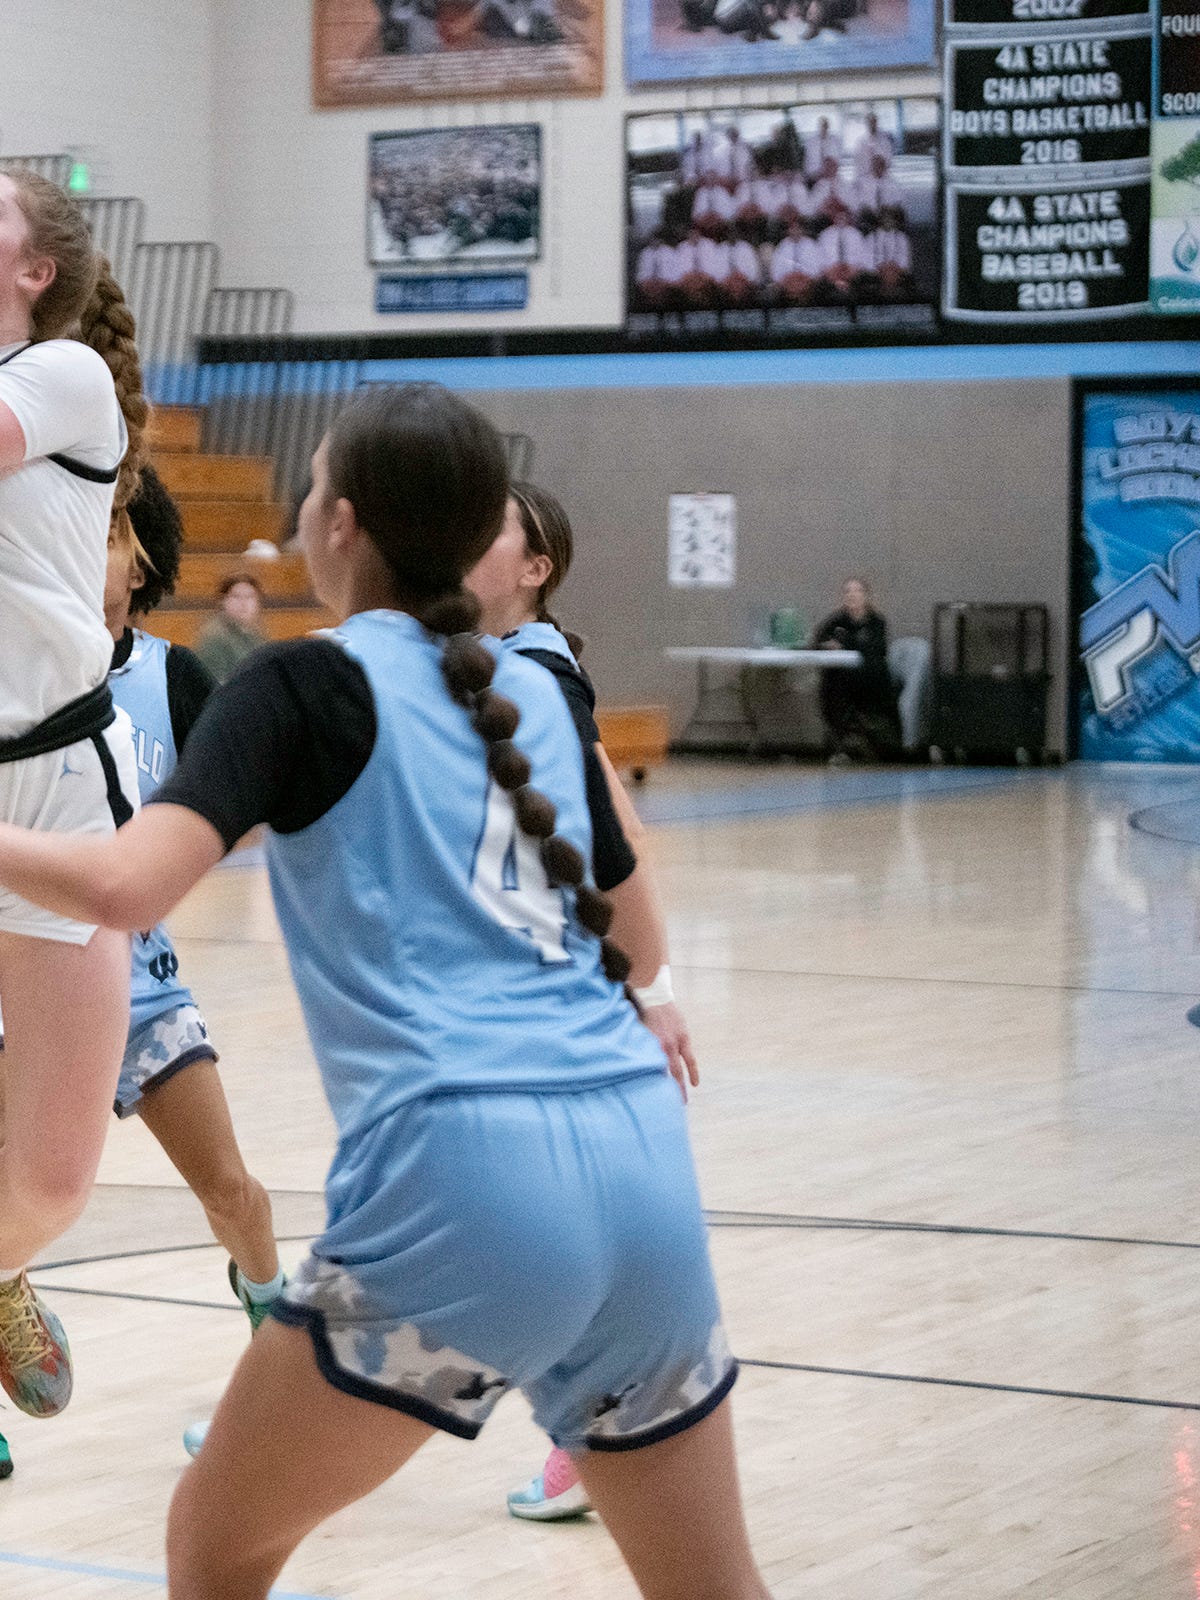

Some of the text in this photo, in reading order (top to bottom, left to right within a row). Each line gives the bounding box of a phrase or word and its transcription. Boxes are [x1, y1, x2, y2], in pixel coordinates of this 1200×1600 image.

[995, 40, 1110, 71] 4A STATE
[983, 72, 1121, 104] CHAMPIONS
[951, 101, 1148, 136] BOYS BASKETBALL
[987, 190, 1121, 222] 4A STATE
[977, 219, 1129, 251] CHAMPIONS
[981, 250, 1124, 281] BASEBALL
[1017, 281, 1088, 309] 2019
[469, 778, 574, 966] 4
